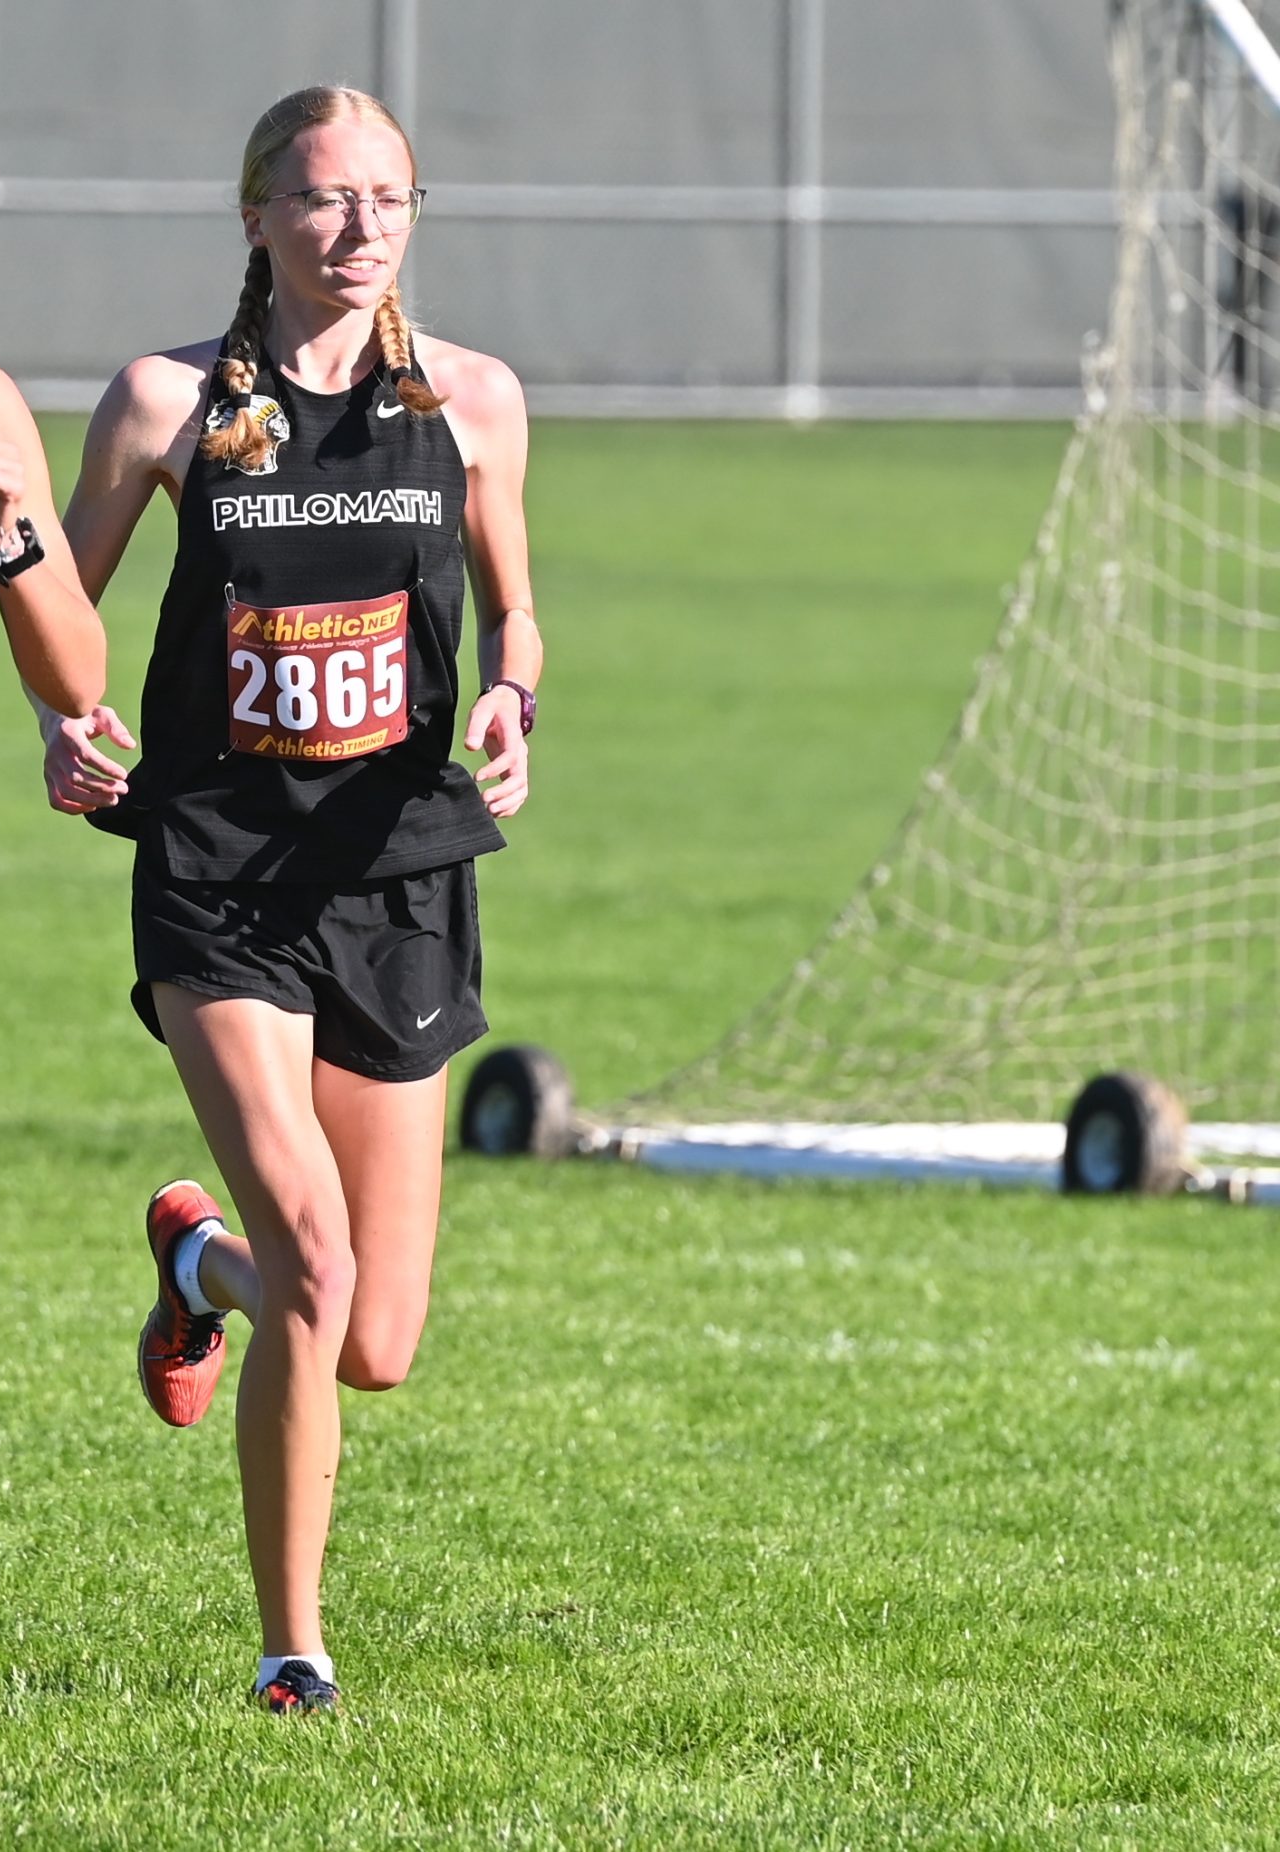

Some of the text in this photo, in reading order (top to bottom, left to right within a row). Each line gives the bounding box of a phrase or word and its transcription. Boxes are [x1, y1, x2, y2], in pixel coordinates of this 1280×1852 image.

[212, 489, 442, 531] PHILOMATH
[231, 610, 399, 643] Athletic NET
[230, 636, 404, 731] 2865
[254, 733, 385, 758] Athletic TIMING
